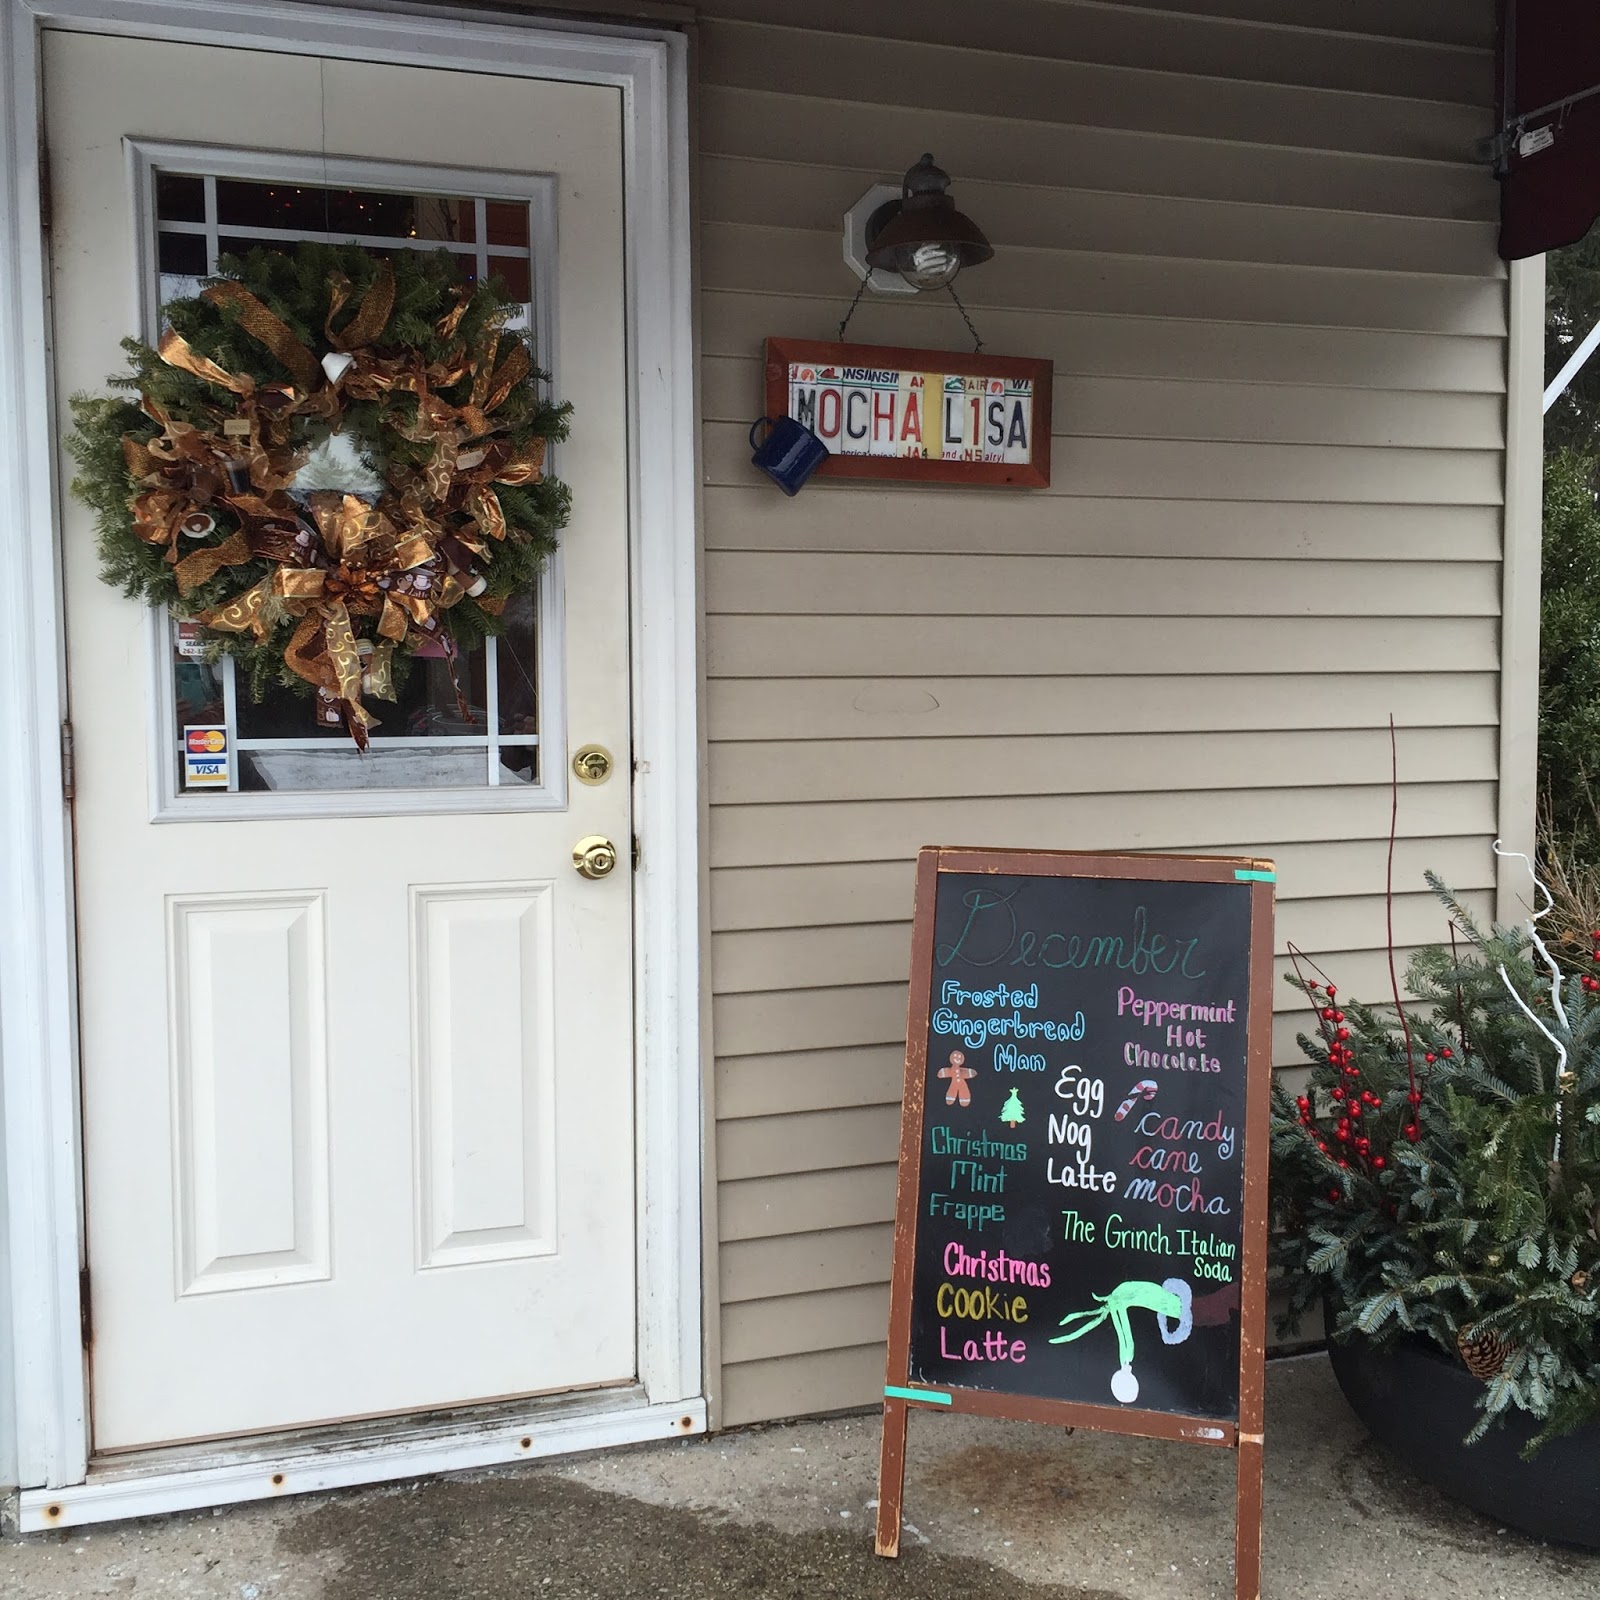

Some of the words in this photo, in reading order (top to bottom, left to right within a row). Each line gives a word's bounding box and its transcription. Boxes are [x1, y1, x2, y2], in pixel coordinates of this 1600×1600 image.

[798, 388, 921, 443] MOCHA
[195, 765, 219, 775] VISA
[936, 884, 1205, 978] December
[941, 980, 1039, 1009] Frosted
[1117, 986, 1236, 1026] Peppermint
[932, 1008, 1085, 1049] Gingerbread
[1167, 1026, 1206, 1049] Hot
[993, 1043, 1046, 1073] Man
[1124, 1042, 1222, 1074] Chocolate
[1054, 1065, 1105, 1118] Egg
[931, 1126, 1028, 1162] Christmas
[1047, 1113, 1092, 1164] Nog
[1134, 1110, 1235, 1160] candy
[951, 1160, 1007, 1194] Mint
[1047, 1157, 1117, 1193] Latte
[1129, 1145, 1202, 1174] cane
[929, 1193, 1006, 1232] Frappe
[1124, 1177, 1231, 1215] mocha
[1062, 1210, 1096, 1244] The
[1105, 1213, 1172, 1256] Grinch
[1176, 1229, 1236, 1261] Italian
[943, 1242, 1051, 1289] Christmas
[1193, 1257, 1233, 1283] Soda
[940, 1326, 1027, 1364] Latte
